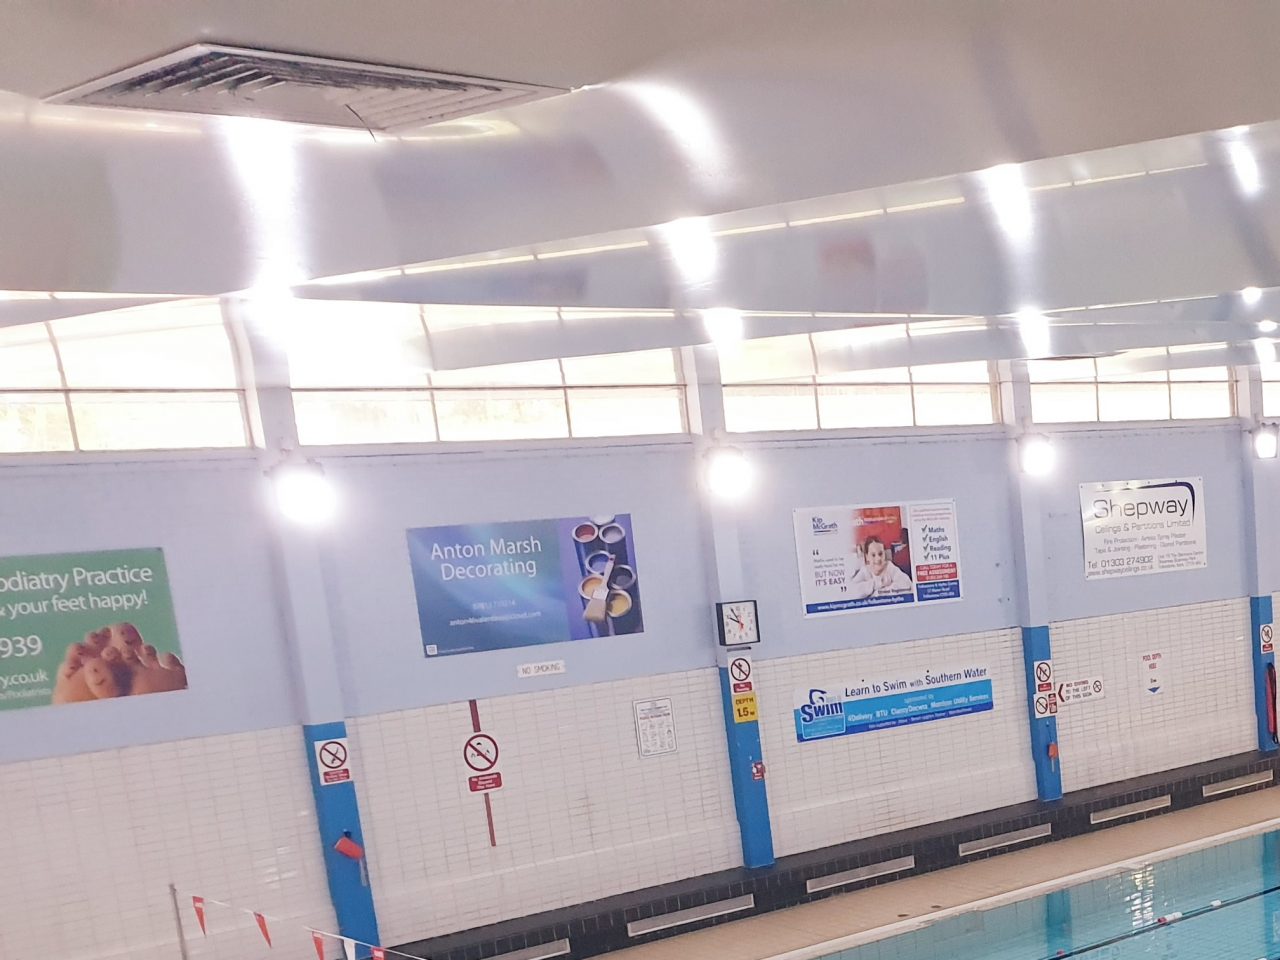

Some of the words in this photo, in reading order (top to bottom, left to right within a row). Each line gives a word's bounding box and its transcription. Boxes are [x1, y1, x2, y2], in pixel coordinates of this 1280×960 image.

[1093, 499, 1188, 519] Shepway
[812, 517, 823, 525] Kip
[1095, 525, 1121, 534] Ceilings
[1124, 523, 1129, 531] &
[1167, 520, 1190, 528] Limited
[431, 543, 485, 560] Anton
[490, 536, 542, 555] Marsh
[440, 558, 537, 581] Decorating
[1088, 561, 1097, 569] Tel
[1101, 558, 1124, 568] 01303
[1126, 555, 1154, 566] 274902
[72, 565, 153, 587] Practice
[829, 577, 846, 586] EASY
[8, 600, 49, 620] your
[51, 594, 87, 612] feet
[88, 589, 149, 611] happy!
[522, 666, 531, 675] NO
[534, 662, 561, 674] SMOKING
[845, 687, 870, 698] Learn
[872, 684, 881, 693] to
[883, 680, 907, 692] Swim
[909, 679, 923, 687] with
[925, 671, 962, 685] Southern
[964, 667, 987, 679] Water
[736, 697, 754, 705] DEPTH
[800, 701, 843, 723] Swim
